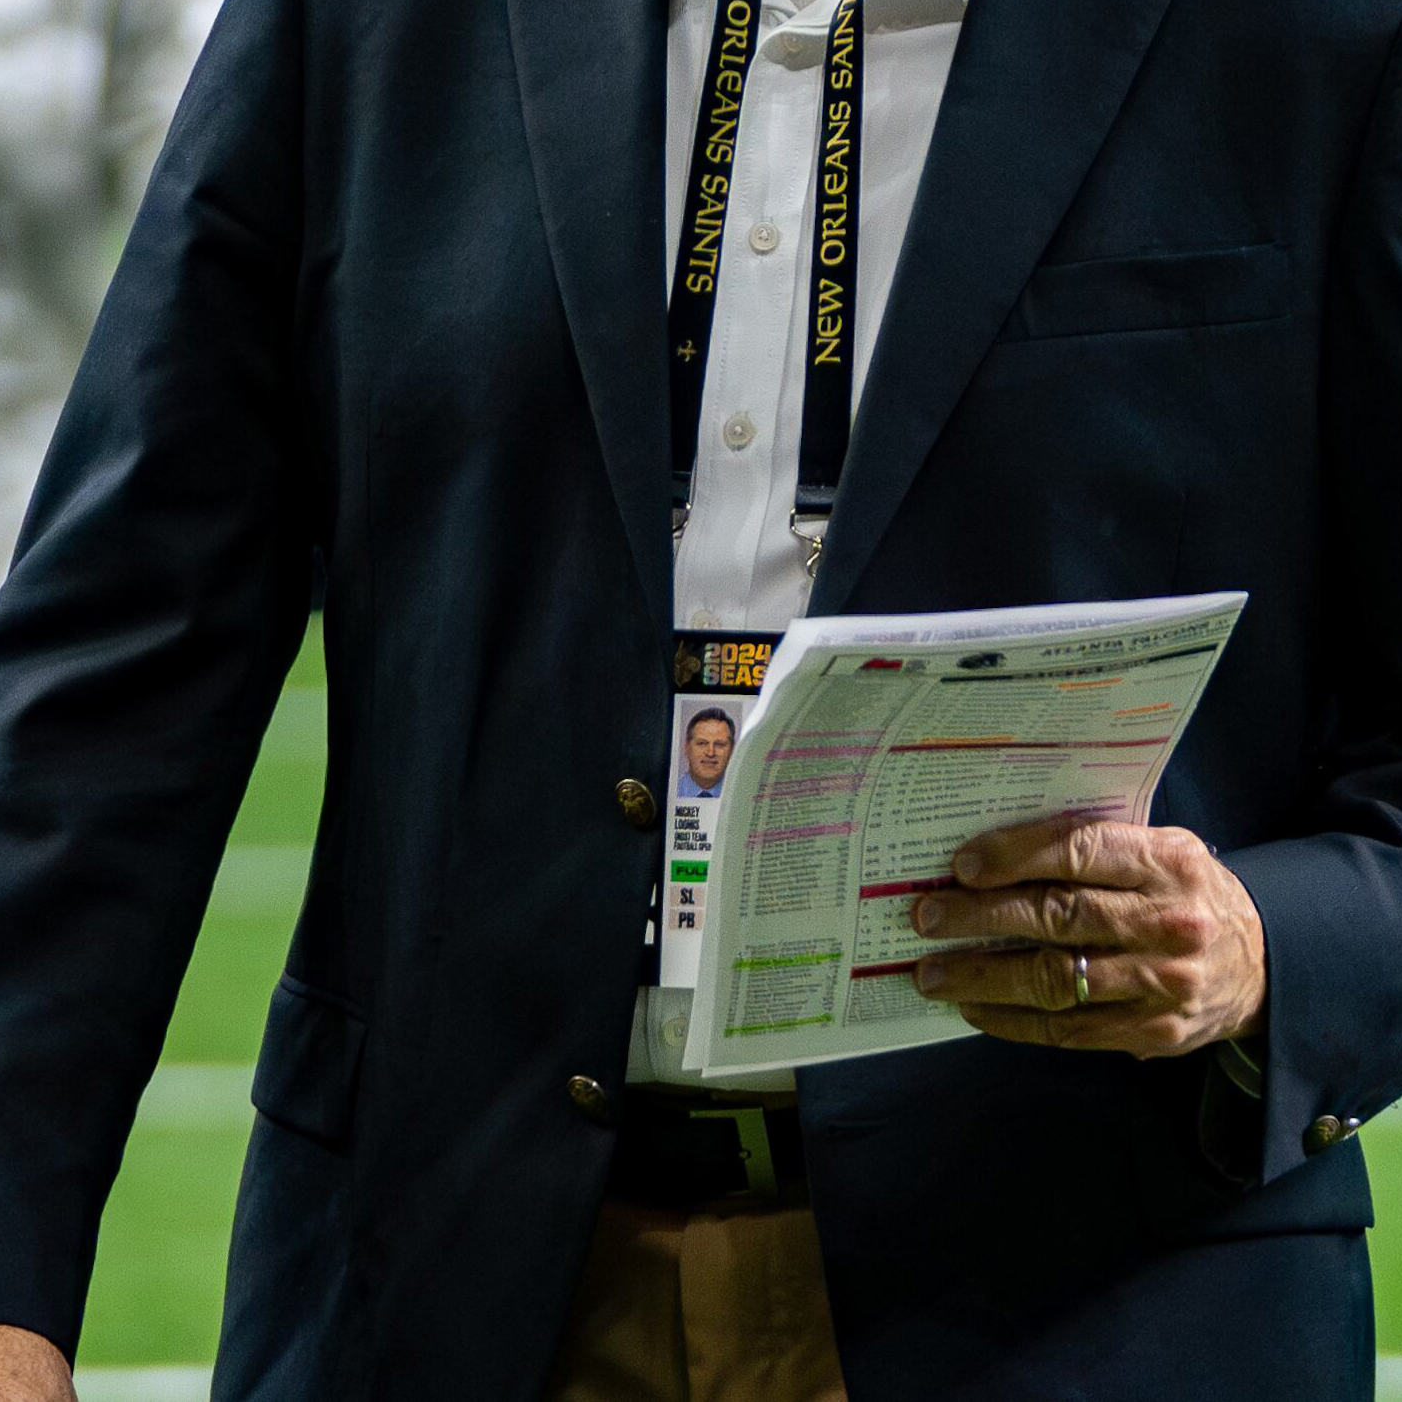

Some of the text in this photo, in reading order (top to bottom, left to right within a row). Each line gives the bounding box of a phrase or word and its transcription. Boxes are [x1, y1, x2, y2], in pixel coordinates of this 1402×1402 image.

[705, 0, 751, 164] ORLEANS
[819, 101, 852, 267] ORLEANS
[686, 174, 729, 293] SAINTS
[814, 278, 844, 366] NEW
[703, 664, 766, 687] SEAS
[704, 642, 771, 665] 2024
[678, 912, 695, 929] PB
[680, 887, 695, 905] SL
